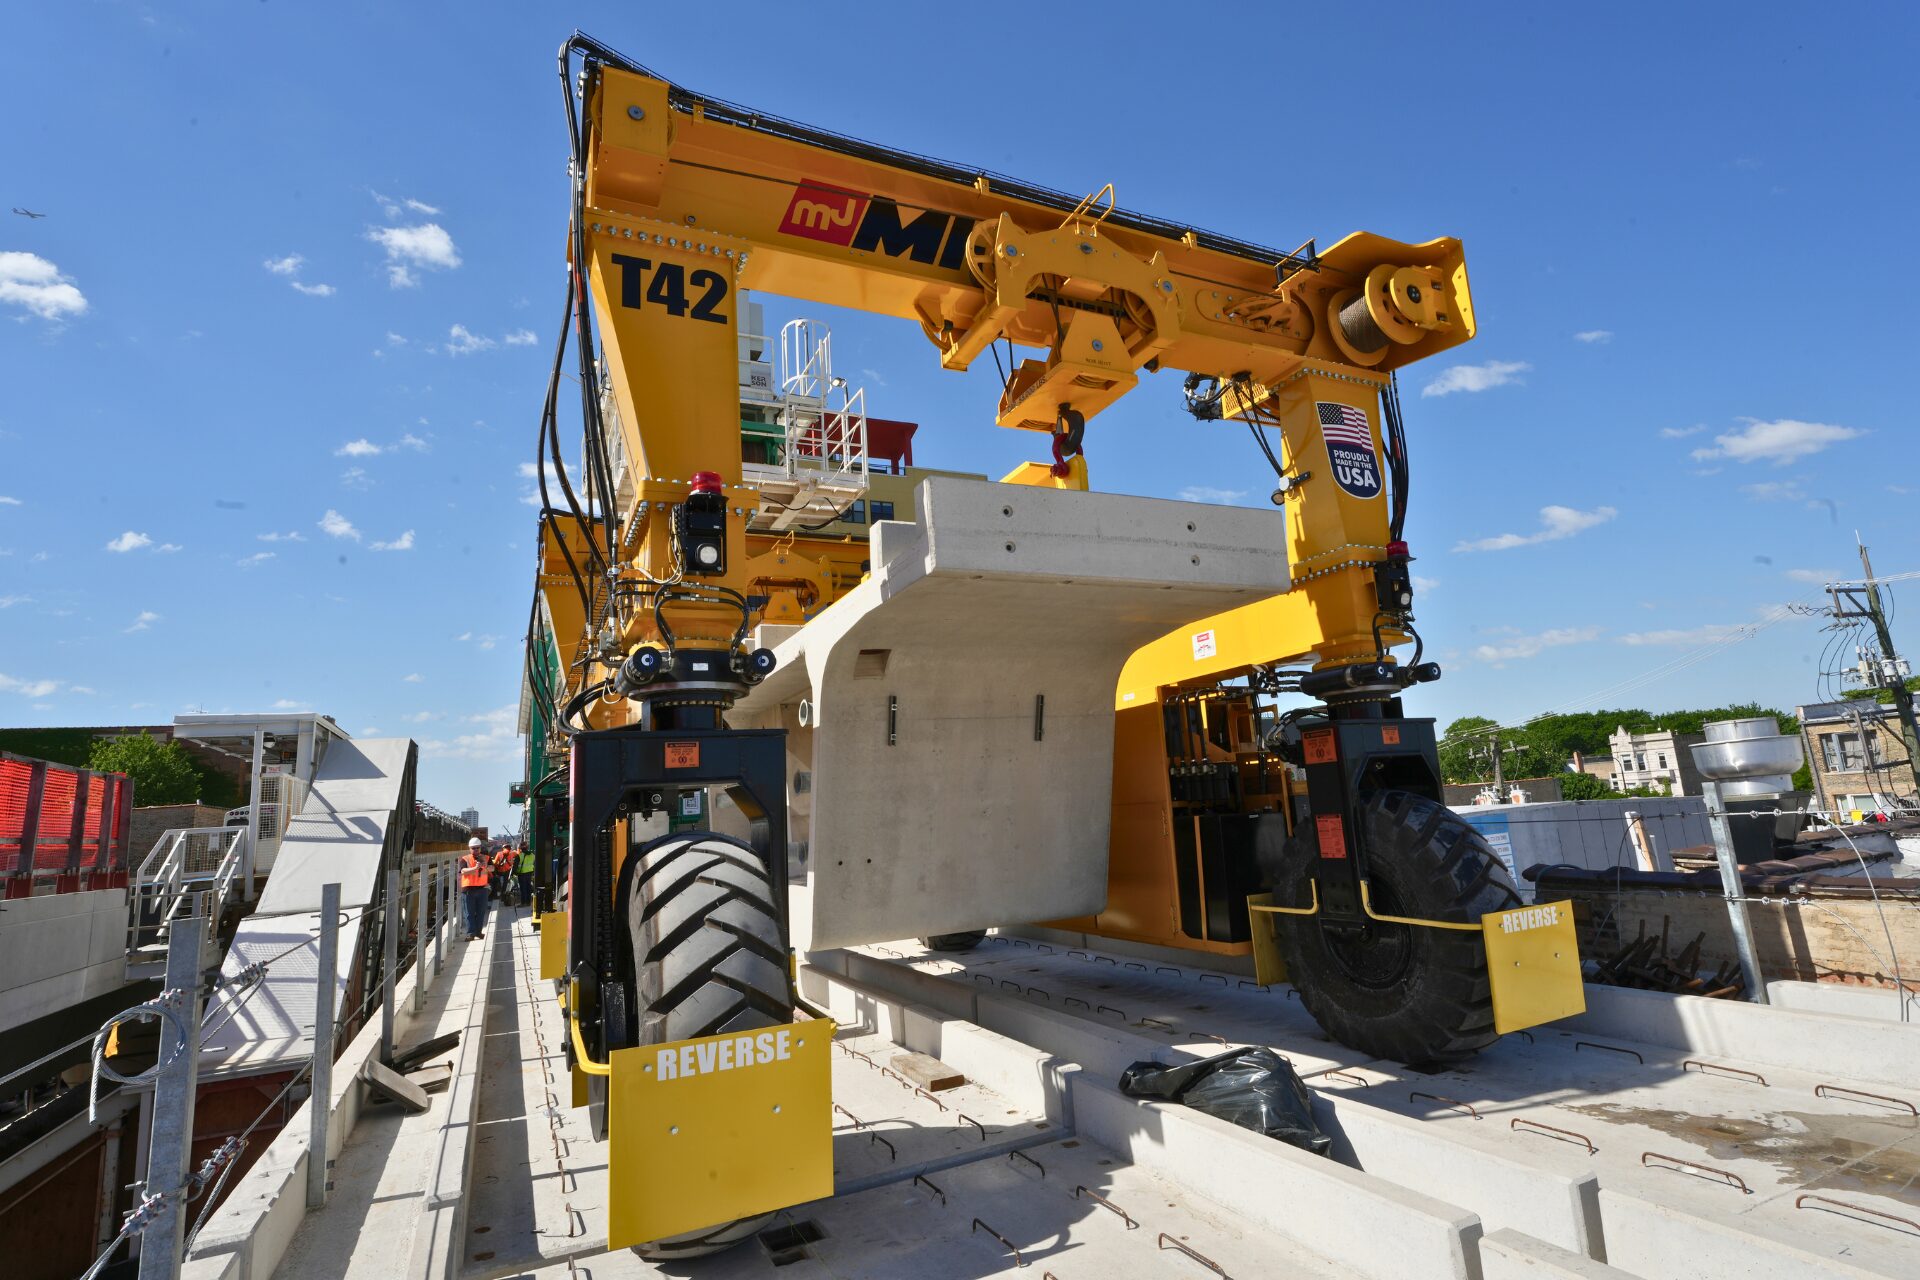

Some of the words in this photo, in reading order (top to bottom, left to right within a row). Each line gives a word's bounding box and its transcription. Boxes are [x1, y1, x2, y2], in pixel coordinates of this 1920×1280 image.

[611, 253, 728, 325] T42
[1333, 449, 1370, 463] PROUDLY
[1335, 458, 1353, 467] MADE
[1353, 460, 1360, 468] IN
[1360, 462, 1373, 470] THE
[1337, 465, 1378, 488] USA
[1502, 906, 1559, 934] REVERSE
[657, 1030, 791, 1081] REVERSE
